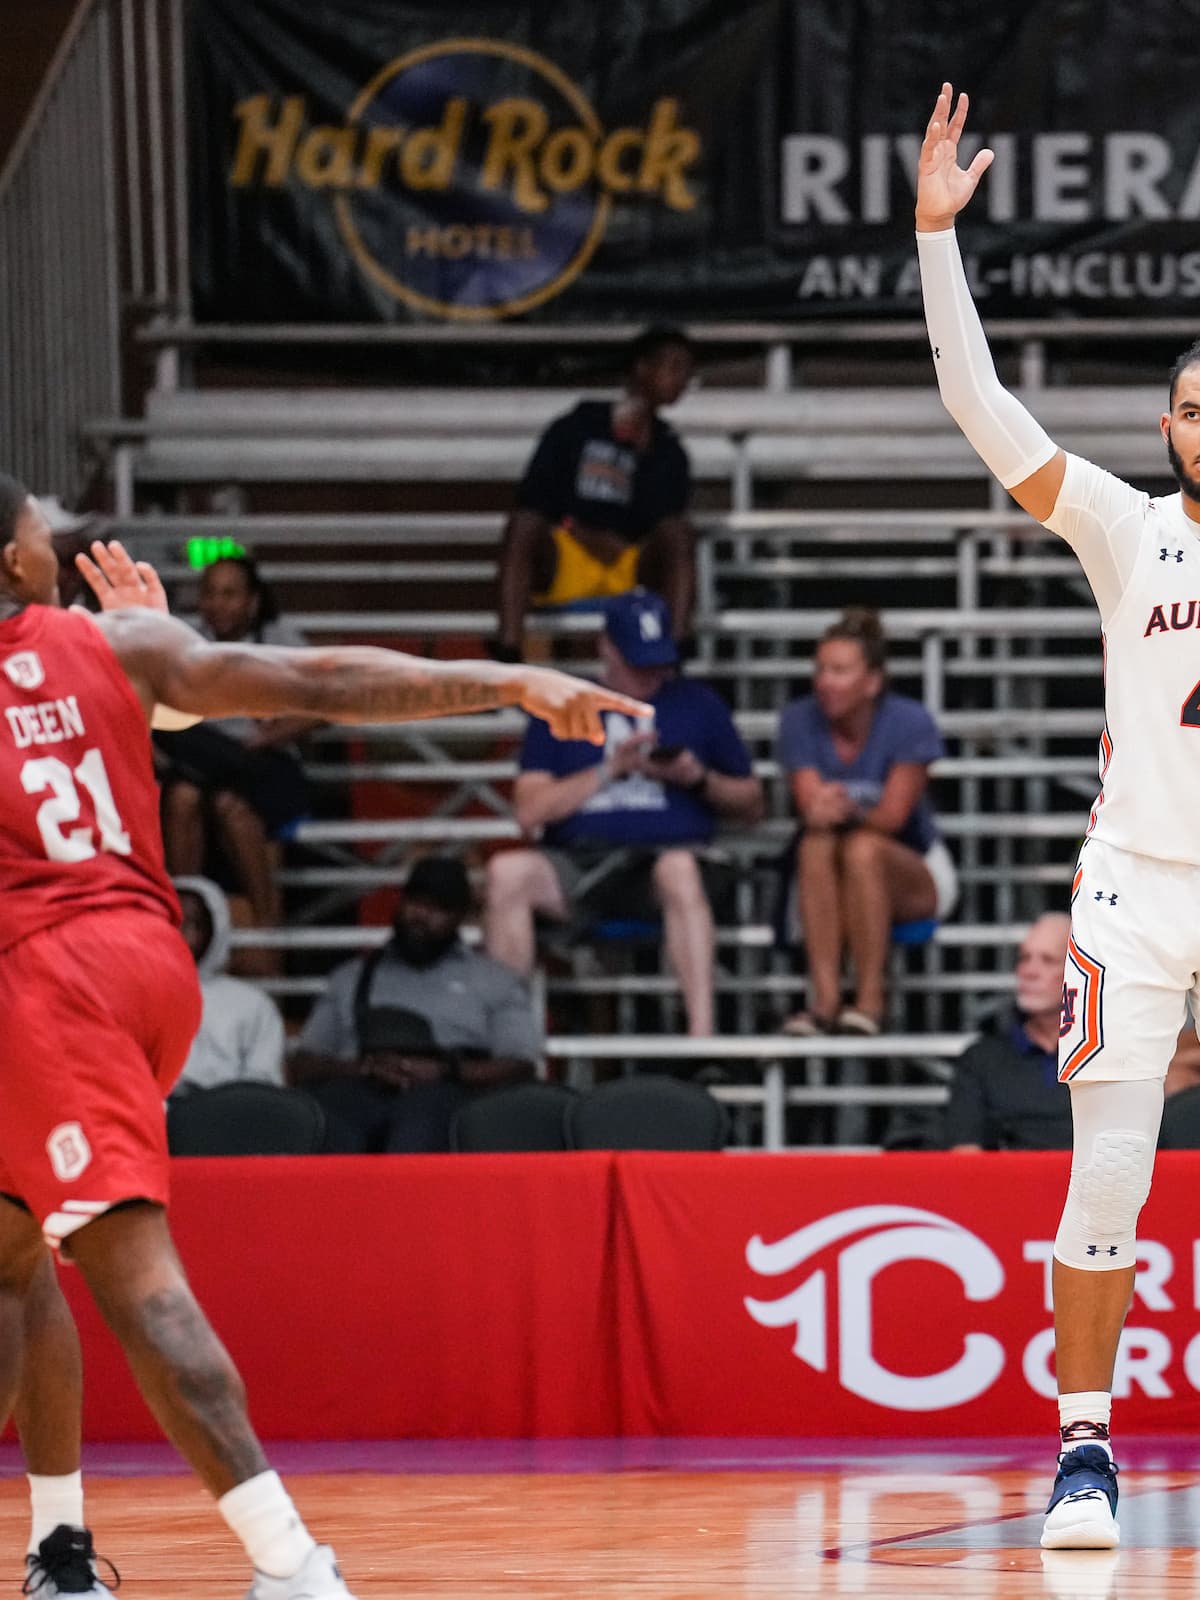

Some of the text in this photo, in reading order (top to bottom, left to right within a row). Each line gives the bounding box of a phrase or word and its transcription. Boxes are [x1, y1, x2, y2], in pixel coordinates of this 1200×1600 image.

[230, 94, 700, 212] Hard Rock
[404, 223, 537, 260] HOTEL
[800, 256, 880, 297] AN
[5, 695, 86, 749] DEEN
[20, 747, 132, 863] 21
